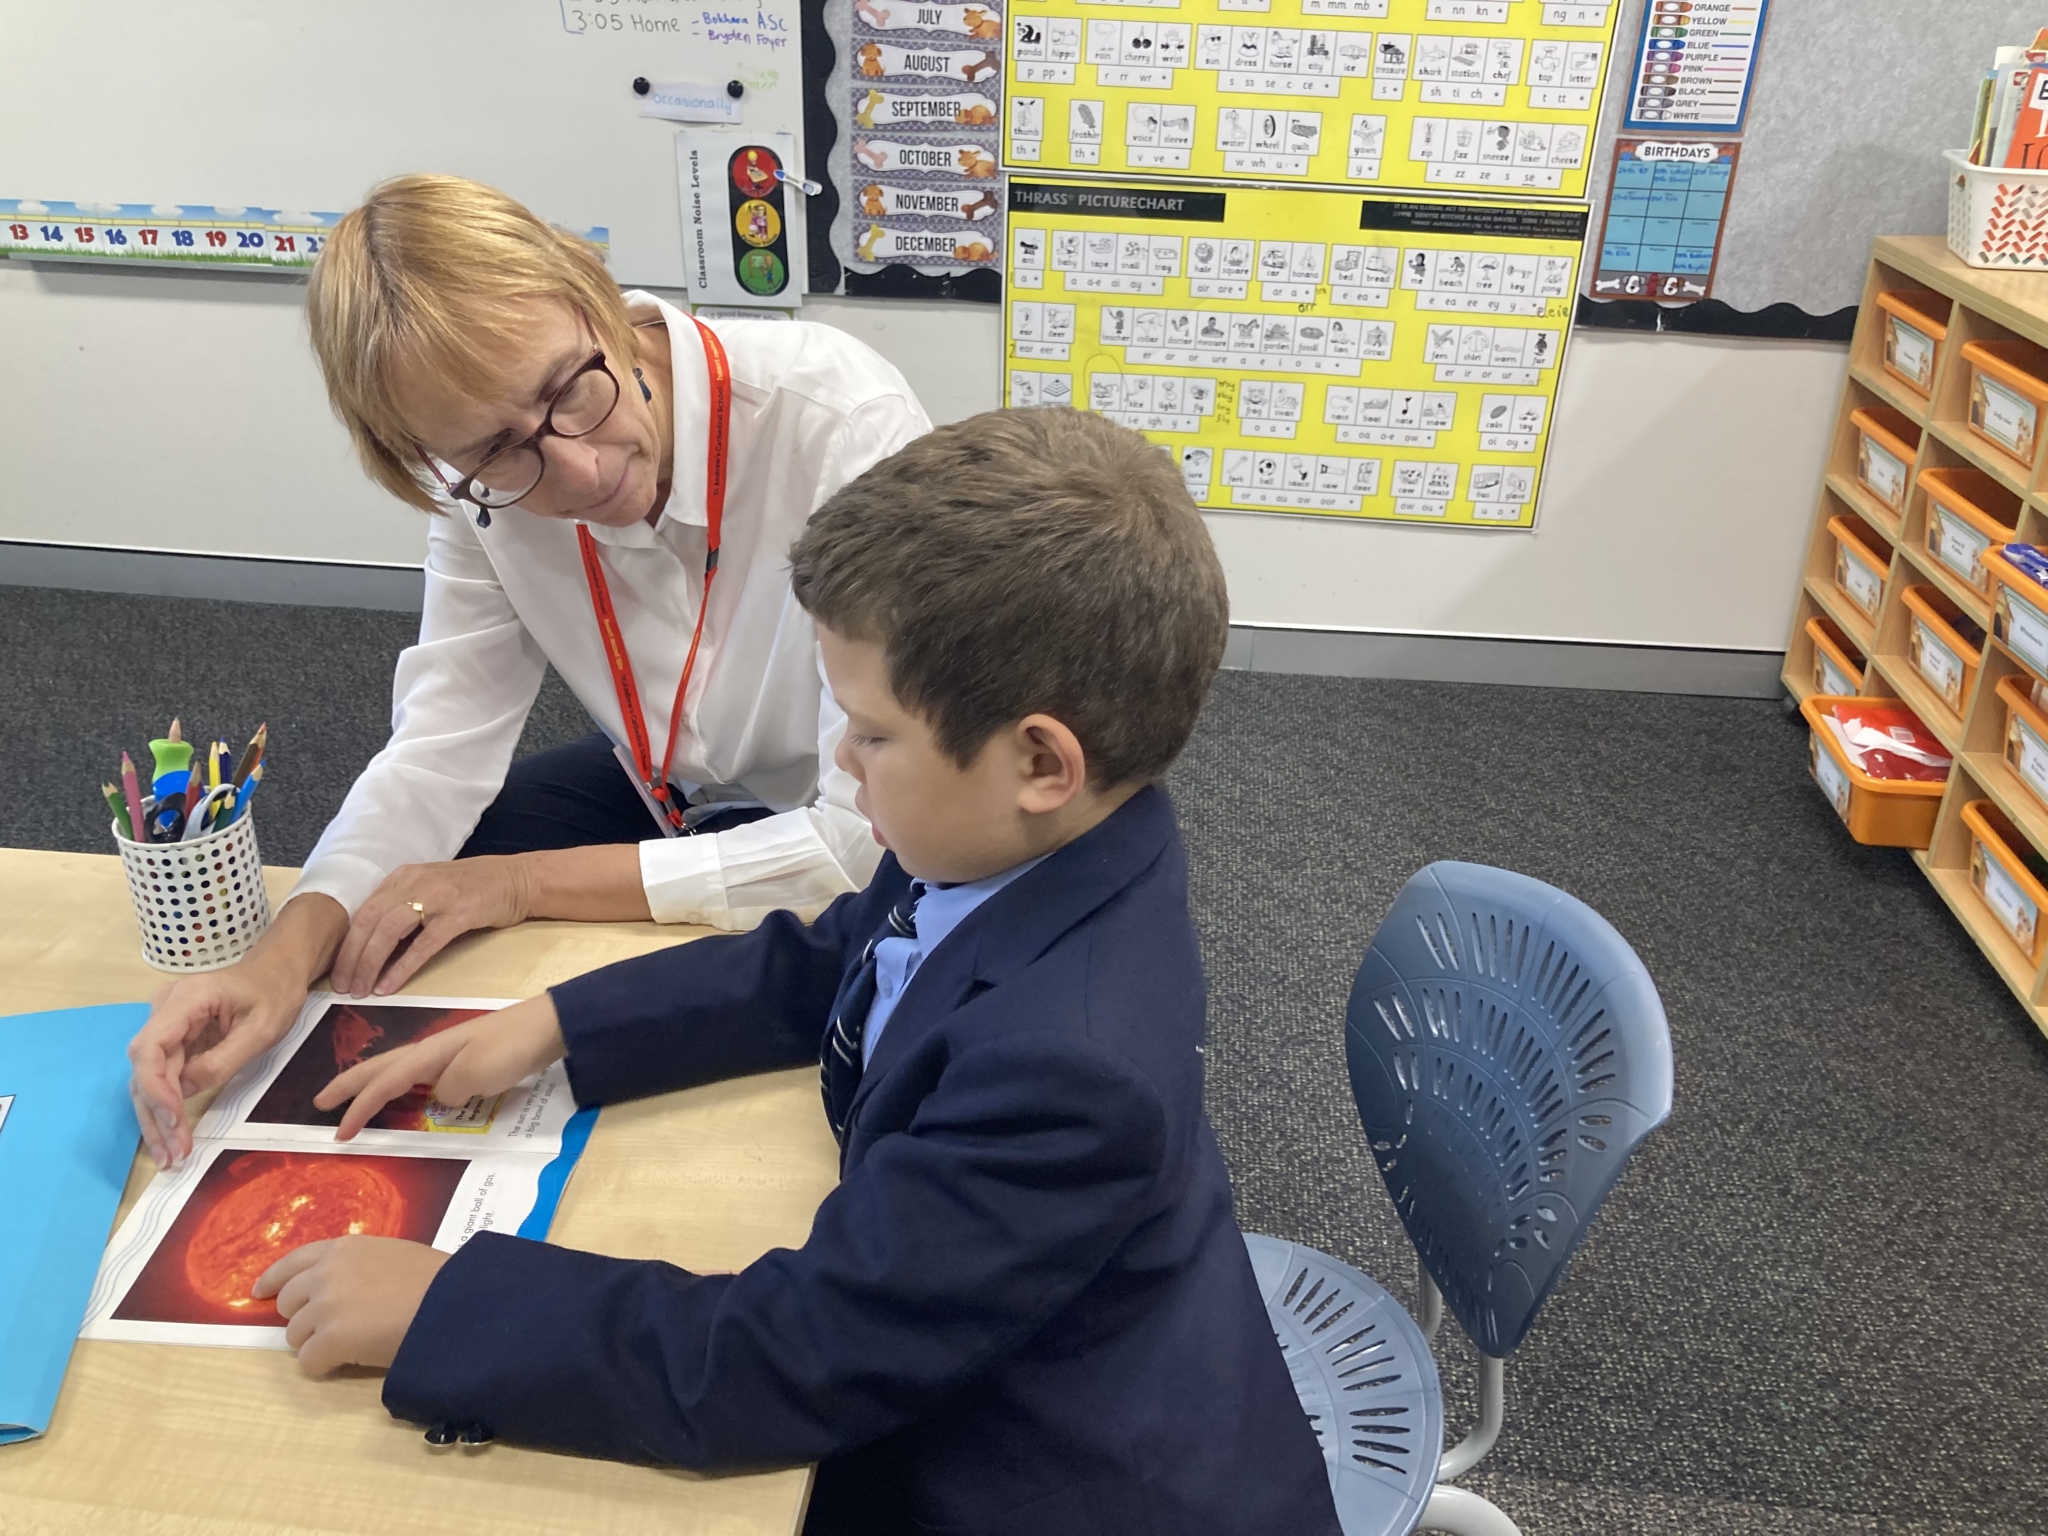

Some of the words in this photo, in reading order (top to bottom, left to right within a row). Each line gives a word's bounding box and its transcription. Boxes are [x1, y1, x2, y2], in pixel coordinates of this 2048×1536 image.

[1452, 6, 1465, 15] nn
[1476, 5, 1488, 16] kn
[1694, 4, 1731, 12] ORANGE
[572, 10, 623, 31] 3:05
[631, 14, 681, 33] Home
[917, 9, 942, 25] JULY
[1554, 9, 1567, 22] ng
[1691, 17, 1727, 26] YELLOW
[1689, 29, 1719, 37] GREEN
[1017, 49, 1042, 58] panda
[1051, 50, 1075, 60] hippo
[1095, 52, 1111, 60] rain
[1124, 53, 1150, 63] cherry
[1162, 54, 1183, 63] wrist
[1685, 53, 1719, 62] PURPLE
[904, 55, 950, 72] AUGUST
[1235, 57, 1258, 67] dress
[1269, 60, 1292, 69] horse
[1308, 62, 1324, 73] city
[1343, 63, 1356, 72] ice
[1683, 65, 1703, 73] PINK
[1043, 68, 1055, 80] pp
[1139, 74, 1152, 82] wr
[1418, 67, 1442, 77] shark
[1451, 68, 1480, 78] station
[1493, 70, 1512, 82] chef
[1538, 73, 1553, 83] tap
[1569, 73, 1592, 84] letter
[1265, 79, 1276, 88] se
[1303, 81, 1313, 90] ce
[1680, 77, 1712, 85] BROWN
[1430, 87, 1442, 97] sh
[1471, 89, 1482, 99] ch
[1678, 88, 1707, 96] BLACK
[653, 93, 732, 115] occasionally
[892, 102, 961, 116] SEPTEMBER
[1676, 100, 1699, 108] GREY
[1673, 112, 1699, 120] WHITE
[1013, 127, 1040, 137] thumb
[1070, 129, 1100, 141] feather
[1132, 134, 1153, 143] voice
[1163, 134, 1188, 144] sleeve
[1016, 145, 1026, 155] th
[1222, 139, 1245, 148] water
[1255, 140, 1280, 150] wheel
[1291, 142, 1310, 153] quilt
[1644, 146, 1711, 158] BIRTHDAYS
[900, 150, 951, 166] OCTOBER
[1075, 148, 1085, 158] th
[1153, 154, 1165, 163] ve
[1421, 148, 1433, 159] zip
[1452, 150, 1468, 161] fizz
[1482, 152, 1509, 162] sneeze
[1520, 153, 1541, 163] laser
[1551, 154, 1578, 165] cheese
[690, 150, 700, 187] Levels
[1251, 158, 1265, 168] wh
[1524, 173, 1535, 182] se
[896, 195, 959, 212] NOVEMBER
[1015, 191, 1068, 206] THRASS
[1078, 194, 1184, 211] PICTURECHART
[693, 192, 702, 224] Noise
[9, 224, 29, 240] 13
[40, 226, 63, 242] 14
[74, 227, 95, 243] 15
[105, 229, 126, 245] 16
[139, 229, 158, 246] 17
[171, 230, 194, 247] 18
[205, 231, 227, 247] 19
[237, 232, 264, 248] 20
[274, 236, 296, 252] 21
[896, 236, 956, 251] DECEMBER
[697, 229, 707, 289] Classroom
[1057, 256, 1078, 269] baby
[1194, 264, 1212, 273] hair
[1222, 266, 1249, 277] square
[1267, 269, 1280, 277] car
[1338, 272, 1353, 281] bed
[1366, 273, 1390, 283] bread
[1197, 284, 1209, 293] air
[1218, 286, 1233, 294] are
[1439, 278, 1463, 288] beach
[1476, 281, 1492, 289] tree
[1510, 283, 1525, 293] key
[1541, 285, 1561, 295] pony
[1363, 347, 1386, 357] circus
[1431, 351, 1448, 361] fern
[1494, 355, 1517, 363] worm
[1533, 356, 1546, 366] fur
[1331, 413, 1349, 421] nose
[1363, 413, 1382, 423] boat
[1395, 417, 1413, 425] note
[1426, 419, 1447, 427] snow
[1486, 420, 1503, 429] coin
[1518, 422, 1533, 432] toy
[715, 415, 723, 452] Cathedral
[1506, 438, 1518, 449] oy
[1352, 483, 1372, 492] door
[1427, 487, 1450, 497] house
[1476, 489, 1490, 499] bus
[1505, 492, 1526, 501] glove
[540, 1097, 548, 1105] of
[456, 1110, 466, 1121] The
[531, 1105, 545, 1121] bowl
[508, 1126, 521, 1137] The
[517, 1114, 527, 1125] sun
[525, 1121, 540, 1132] big
[478, 1187, 488, 1196] of
[470, 1197, 484, 1212] ball
[463, 1214, 478, 1234] giant
